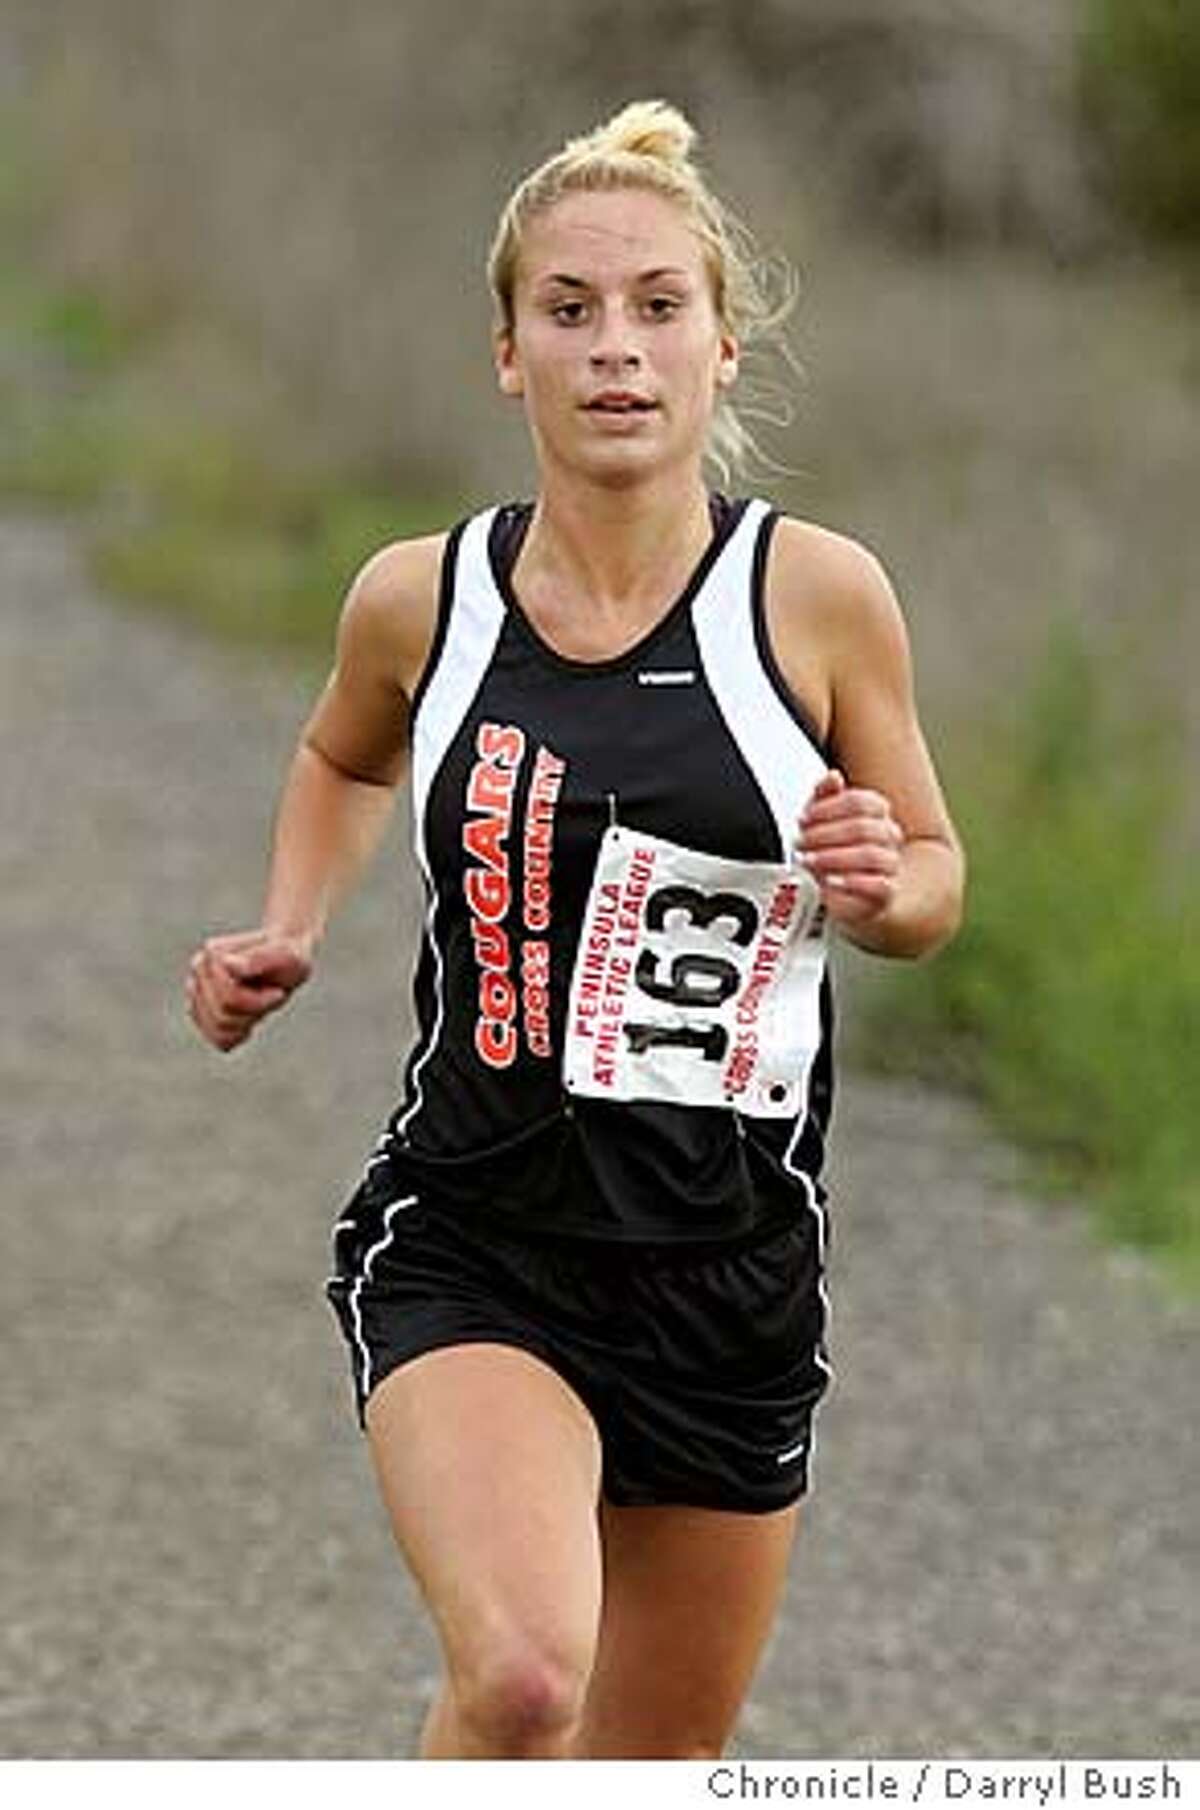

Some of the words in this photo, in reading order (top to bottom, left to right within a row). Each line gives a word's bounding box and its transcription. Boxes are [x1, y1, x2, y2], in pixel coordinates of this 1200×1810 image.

[463, 722, 525, 1069] COUGARS
[523, 745, 566, 931] COUNTRY
[521, 940, 553, 1057] CROSS
[575, 883, 622, 1037] PENINSULA
[593, 956, 631, 1087] ATHLETIC
[623, 849, 656, 948] LEAGUE
[623, 884, 759, 1061] 163
